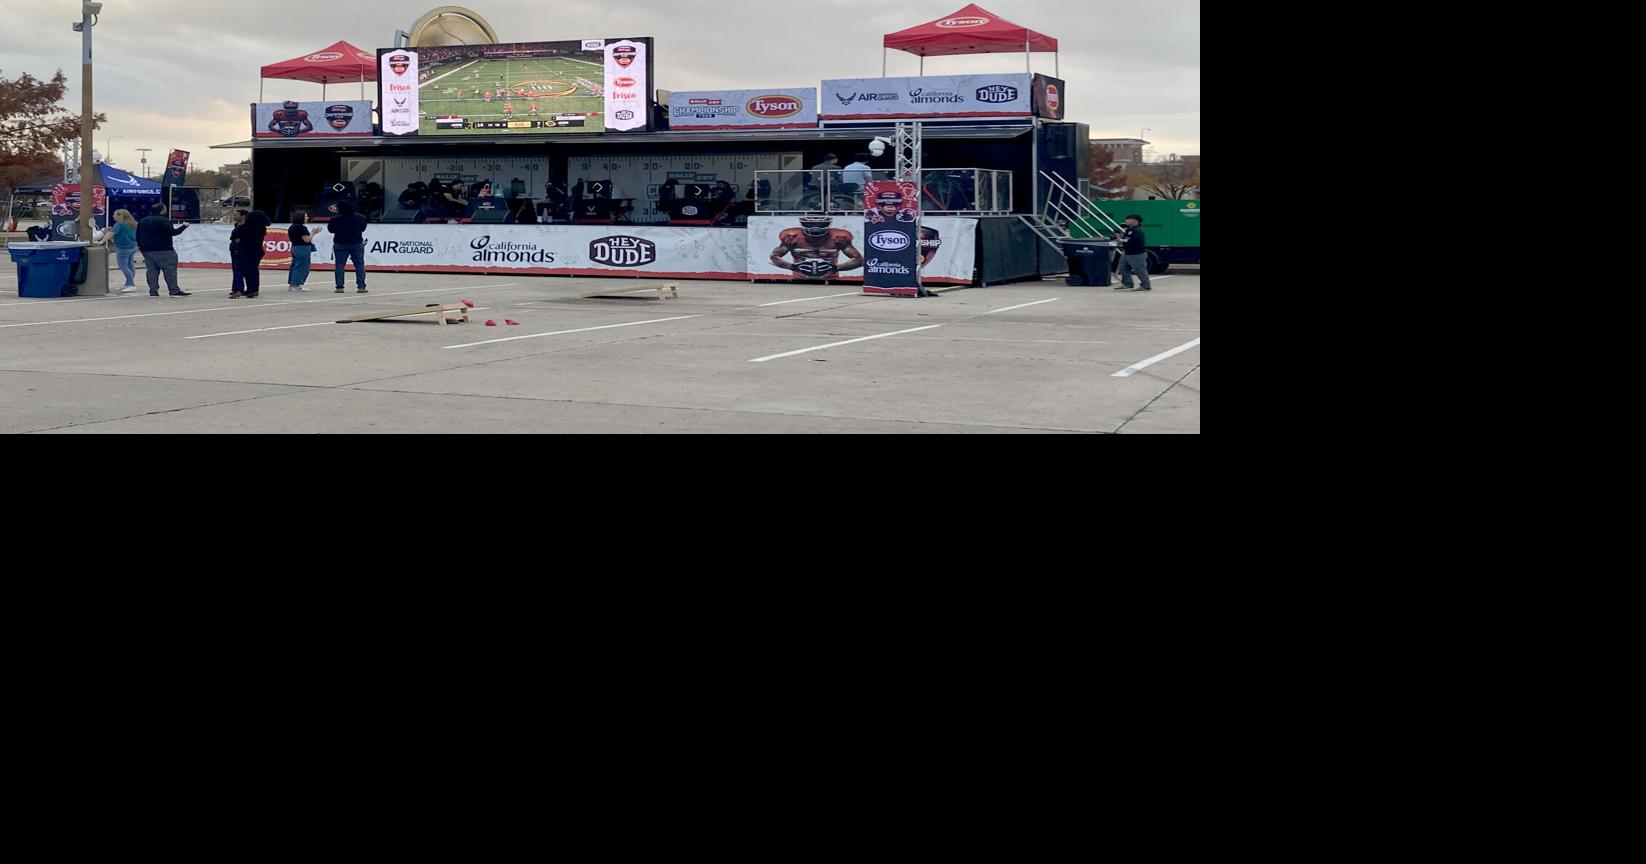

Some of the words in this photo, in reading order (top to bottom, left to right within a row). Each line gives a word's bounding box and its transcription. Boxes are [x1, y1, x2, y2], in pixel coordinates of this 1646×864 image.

[944, 18, 985, 26] Tyson
[612, 92, 636, 100] Frisco
[858, 93, 877, 101] AIR
[910, 95, 964, 103] almonds
[978, 89, 1017, 102] DUDE
[673, 106, 740, 117] CHAMPIONSHIP
[752, 99, 798, 114] Tyson
[489, 241, 537, 250] california
[609, 237, 640, 249] HEY
[874, 234, 907, 247] Tyson
[370, 241, 398, 253] AIR
[399, 246, 434, 254] GUARD
[472, 248, 555, 263] almonds
[593, 242, 653, 265] DUDE
[868, 265, 910, 275] almonds
